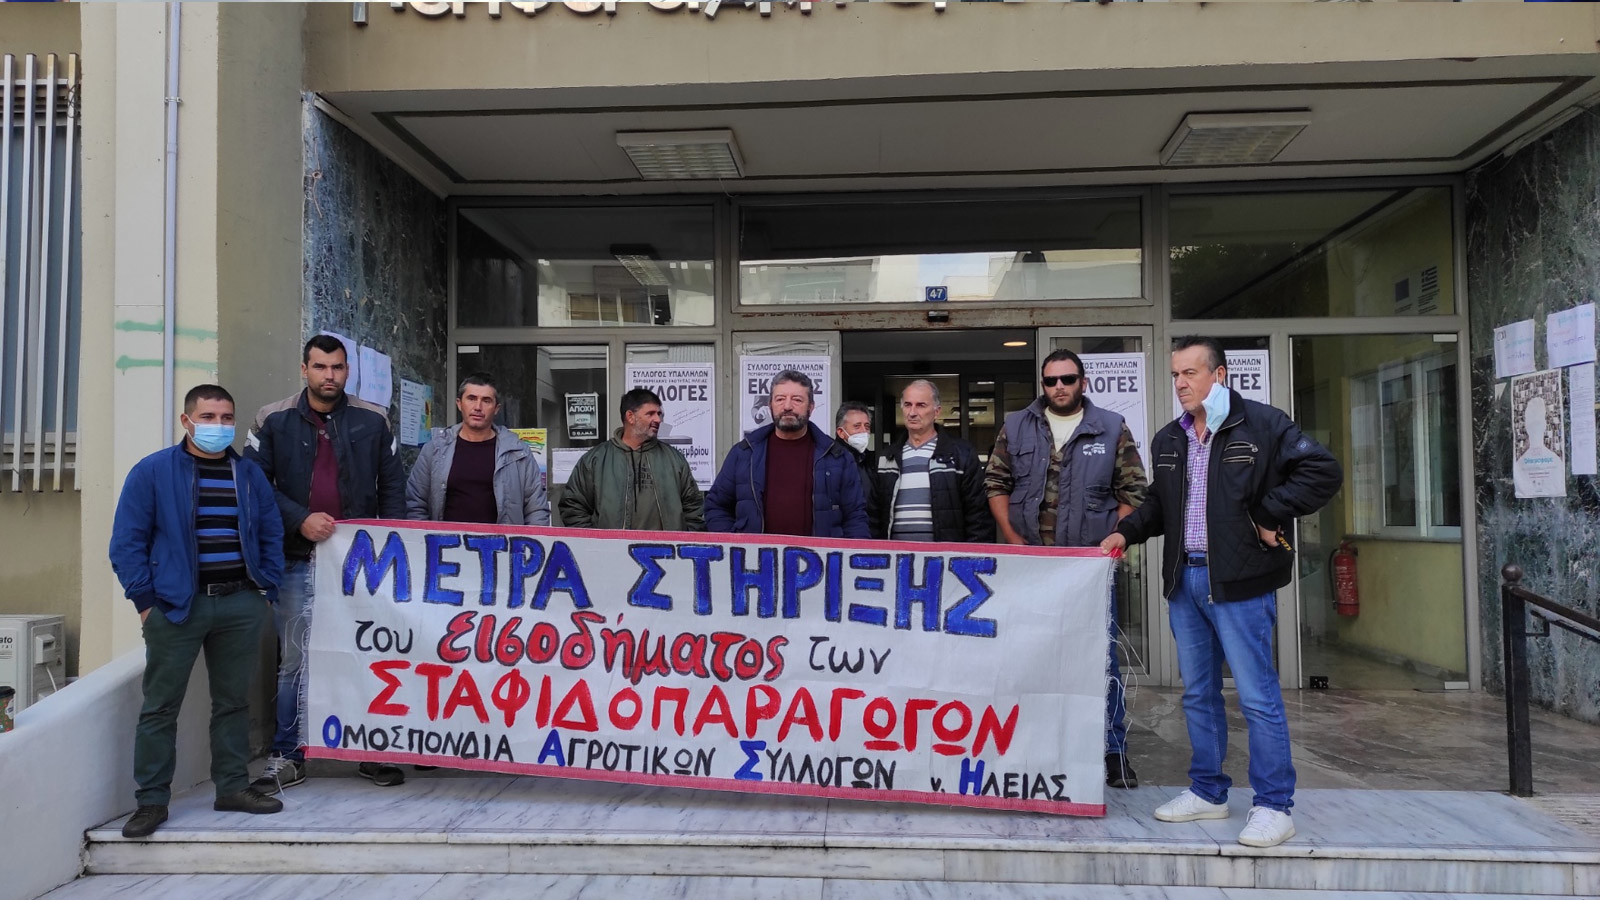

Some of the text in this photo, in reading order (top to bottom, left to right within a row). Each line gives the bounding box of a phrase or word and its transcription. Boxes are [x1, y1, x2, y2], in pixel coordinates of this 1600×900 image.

[930, 289, 943, 299] 47
[747, 363, 824, 371] ΣΥΛΛΟΓΟΣ ΥΠΑΛΛΗΛΩΝ
[1096, 361, 1138, 369] ΥΠΑΛΛΗΛΩΝ
[1083, 376, 1138, 393] ΛΟΓΕΣ
[569, 405, 595, 413] ΑΠΟΧΗ
[342, 529, 998, 637] ΜΕΤΡΑ ΣΤΗΡΙΞΗΣ
[355, 620, 413, 653] του
[809, 636, 891, 675] των
[367, 660, 1019, 757] ΣΤΑΦΙΔΟΠΑΡΑΓΩΓΩΝ
[322, 715, 514, 763] ΟΜΟΣΠΟΝΔΙΑ
[537, 729, 716, 777] ΑΓΡΟΤΙΚΩΝ
[734, 740, 896, 790] ΣΥΛΛΟΓΩΝ
[959, 758, 1071, 802] ΗΛΕΙΑΣ
